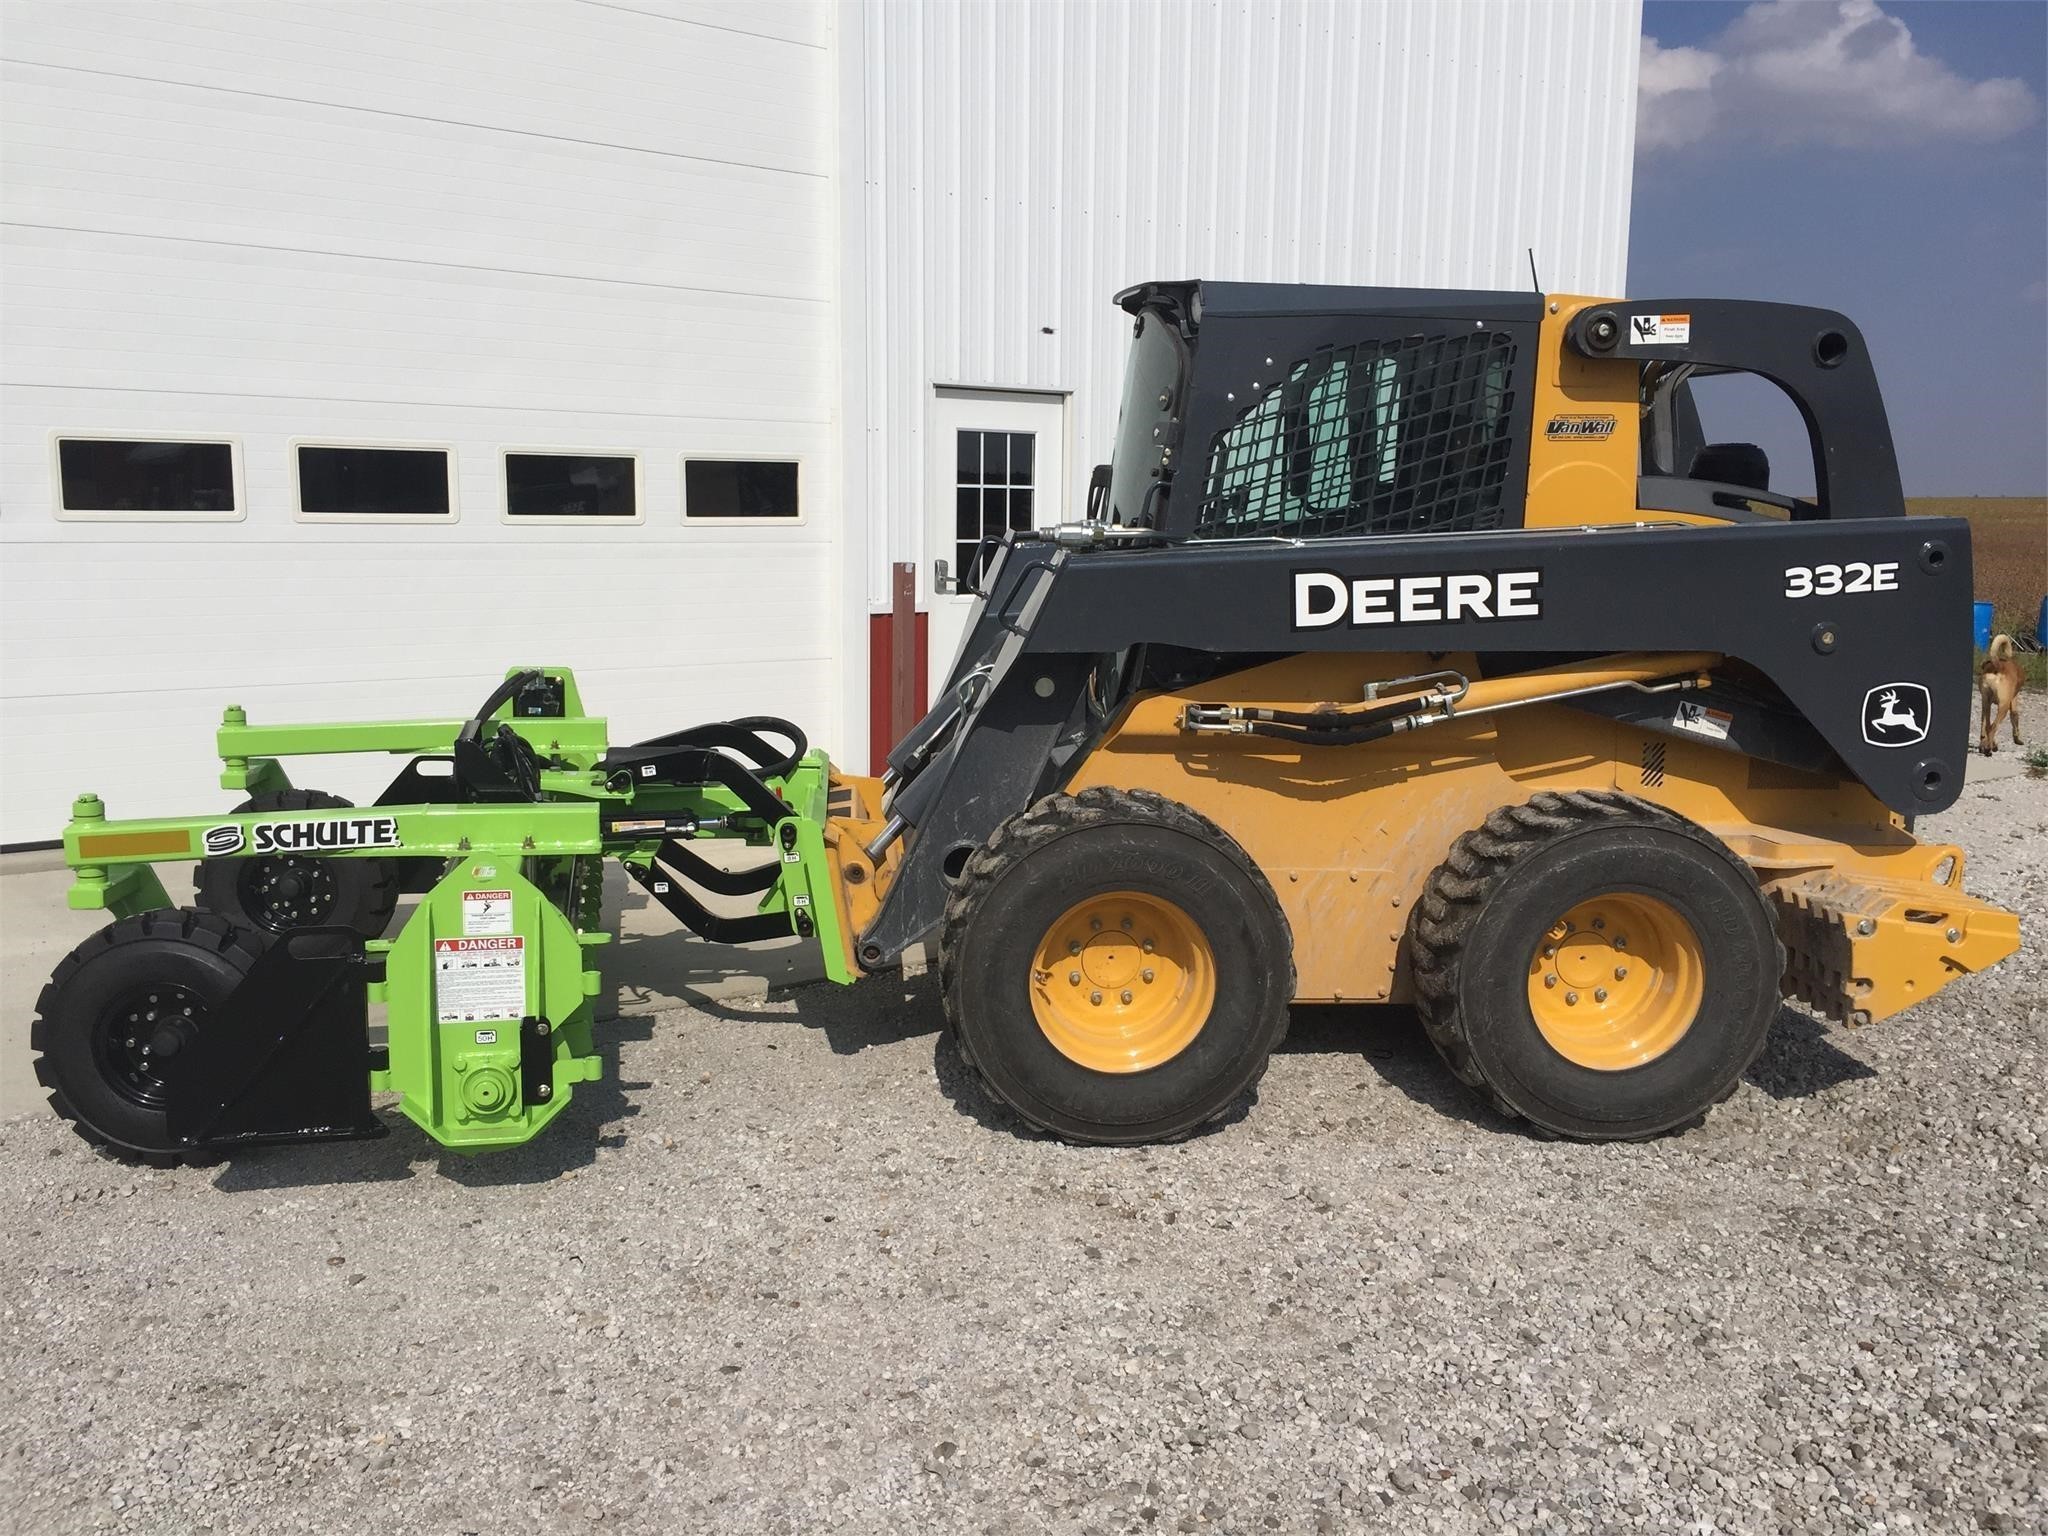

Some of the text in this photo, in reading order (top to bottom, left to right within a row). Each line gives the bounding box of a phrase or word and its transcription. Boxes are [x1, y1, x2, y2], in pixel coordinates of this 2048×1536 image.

[1785, 562, 1899, 598] 332E
[1295, 571, 1539, 627] DEERE
[255, 819, 393, 850] SCHULTE
[475, 892, 509, 900] DANGER
[458, 938, 517, 950] DANGER
